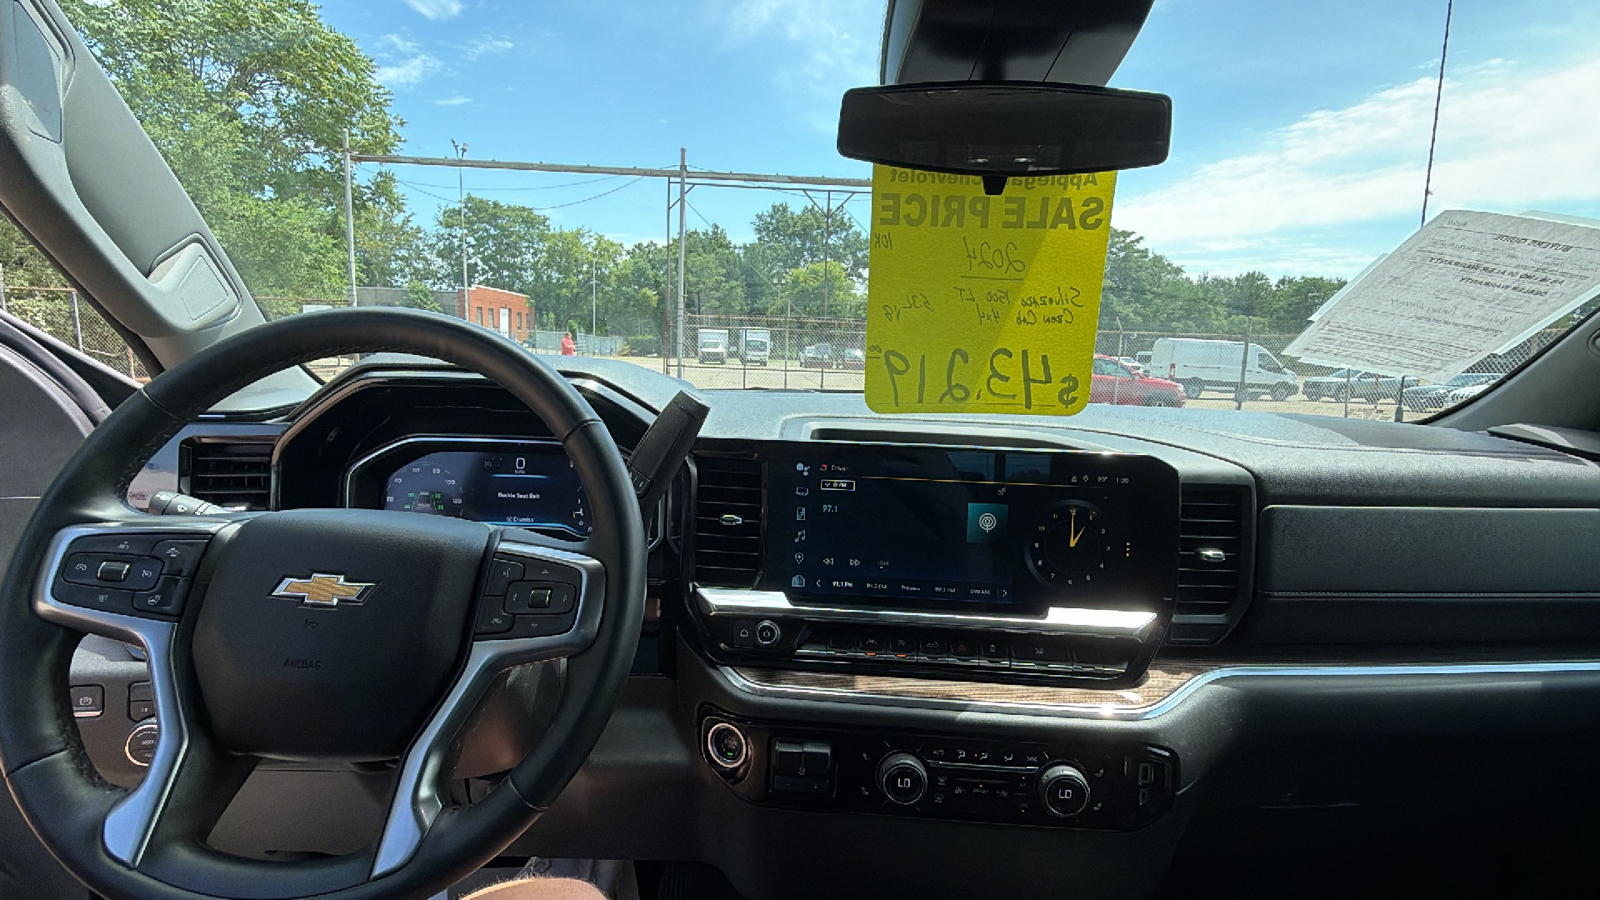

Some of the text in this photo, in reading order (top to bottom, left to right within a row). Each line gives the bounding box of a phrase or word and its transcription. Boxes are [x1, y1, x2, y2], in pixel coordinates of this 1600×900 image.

[515, 457, 526, 470] 0
[822, 504, 838, 512] 97.1
[283, 658, 322, 670] AIRBAG
